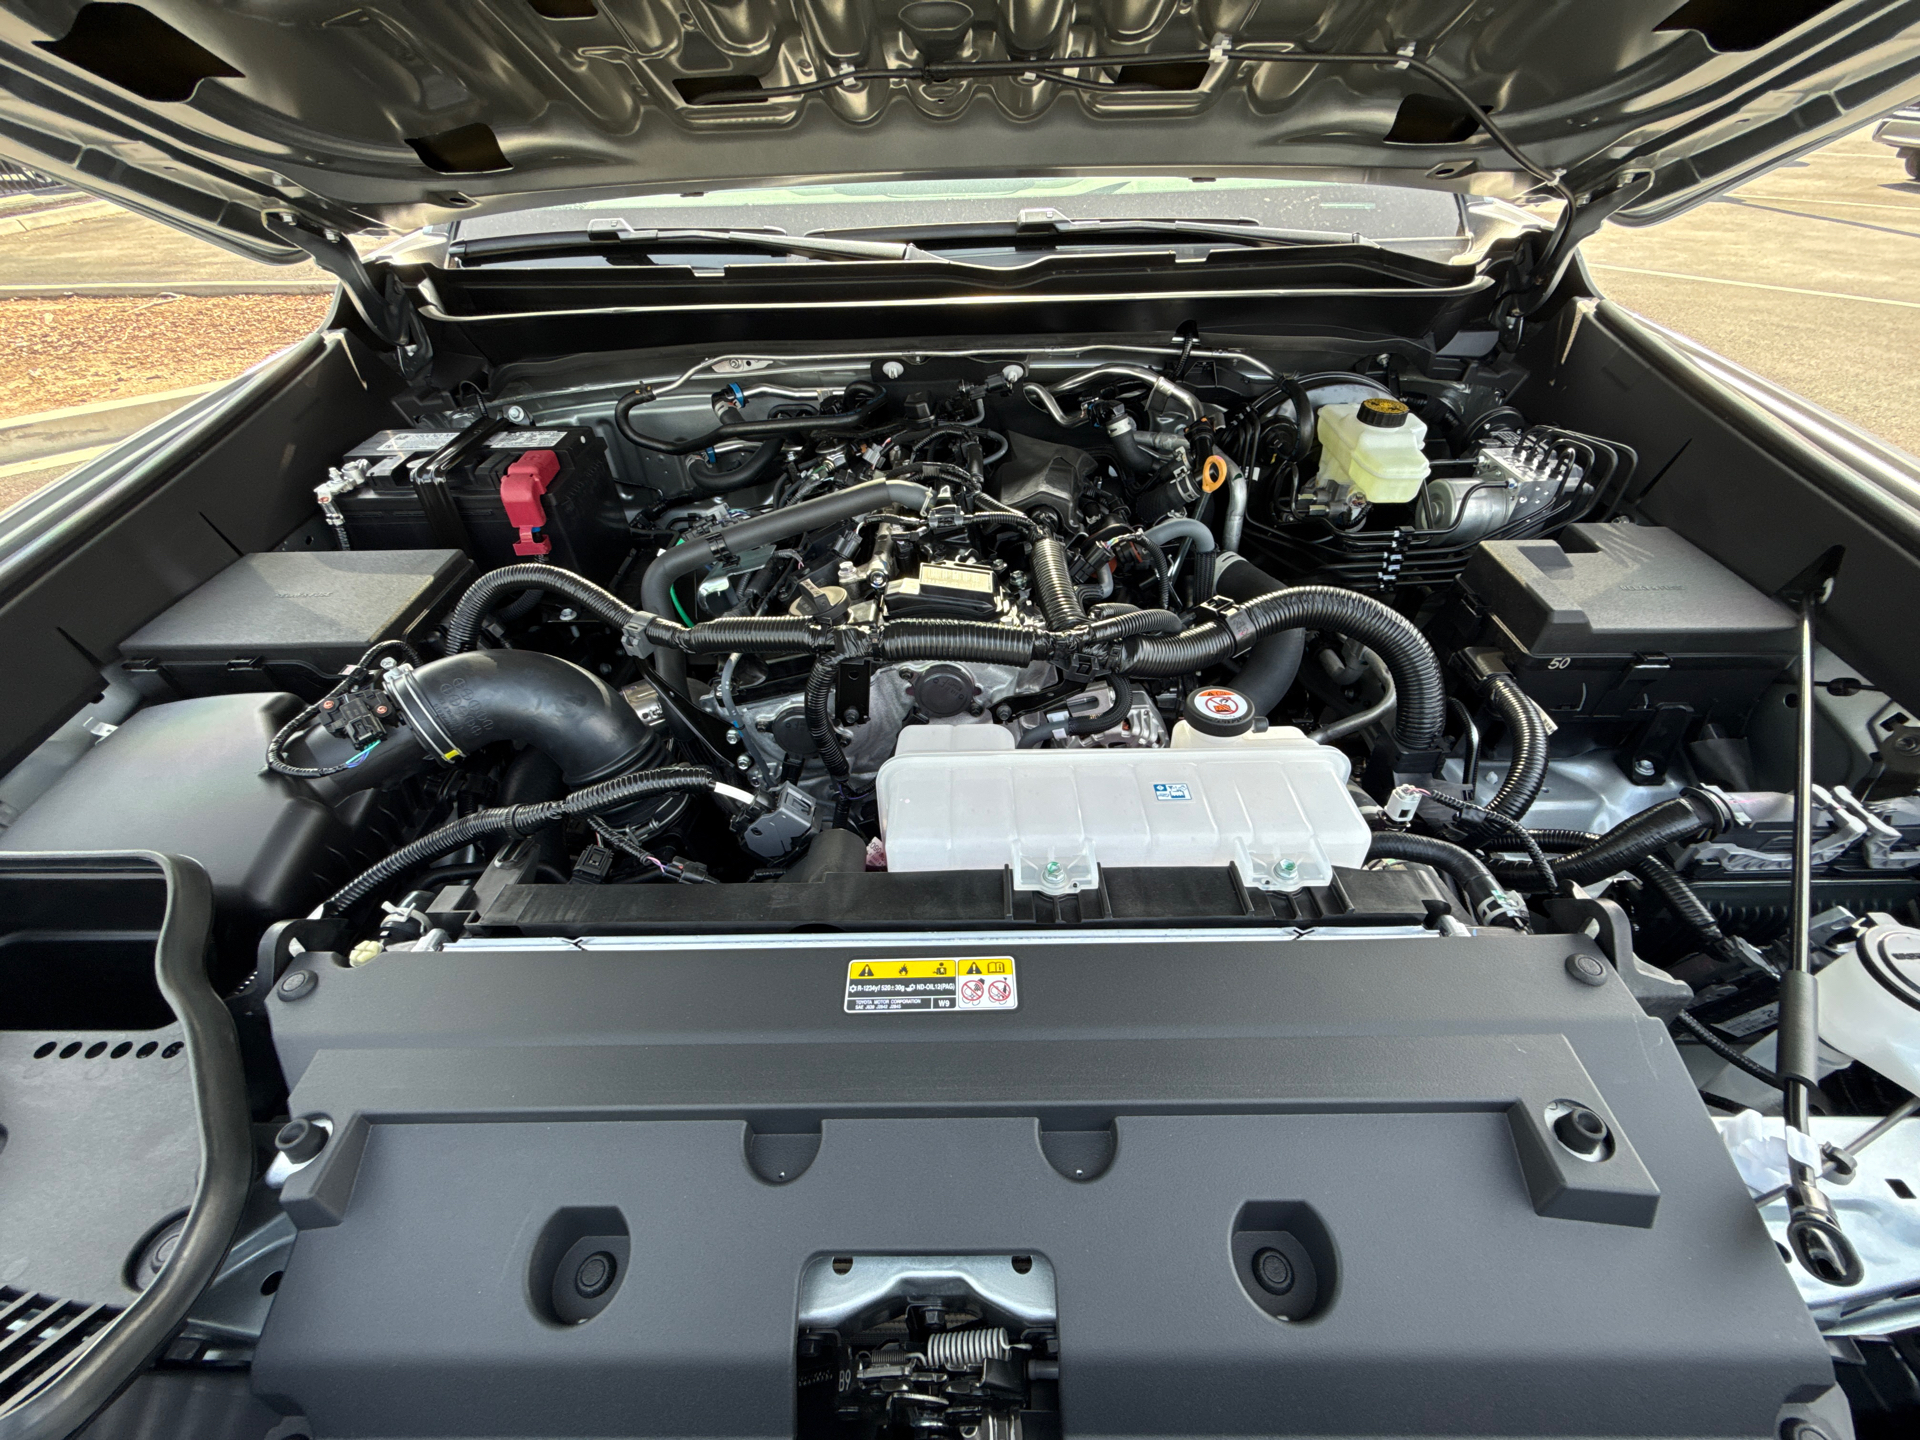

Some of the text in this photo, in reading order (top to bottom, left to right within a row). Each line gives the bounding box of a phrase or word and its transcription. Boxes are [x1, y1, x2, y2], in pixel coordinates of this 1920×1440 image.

[1548, 657, 1571, 670] 50
[857, 984, 880, 992] R-1234yf
[839, 1369, 851, 1392] B9
